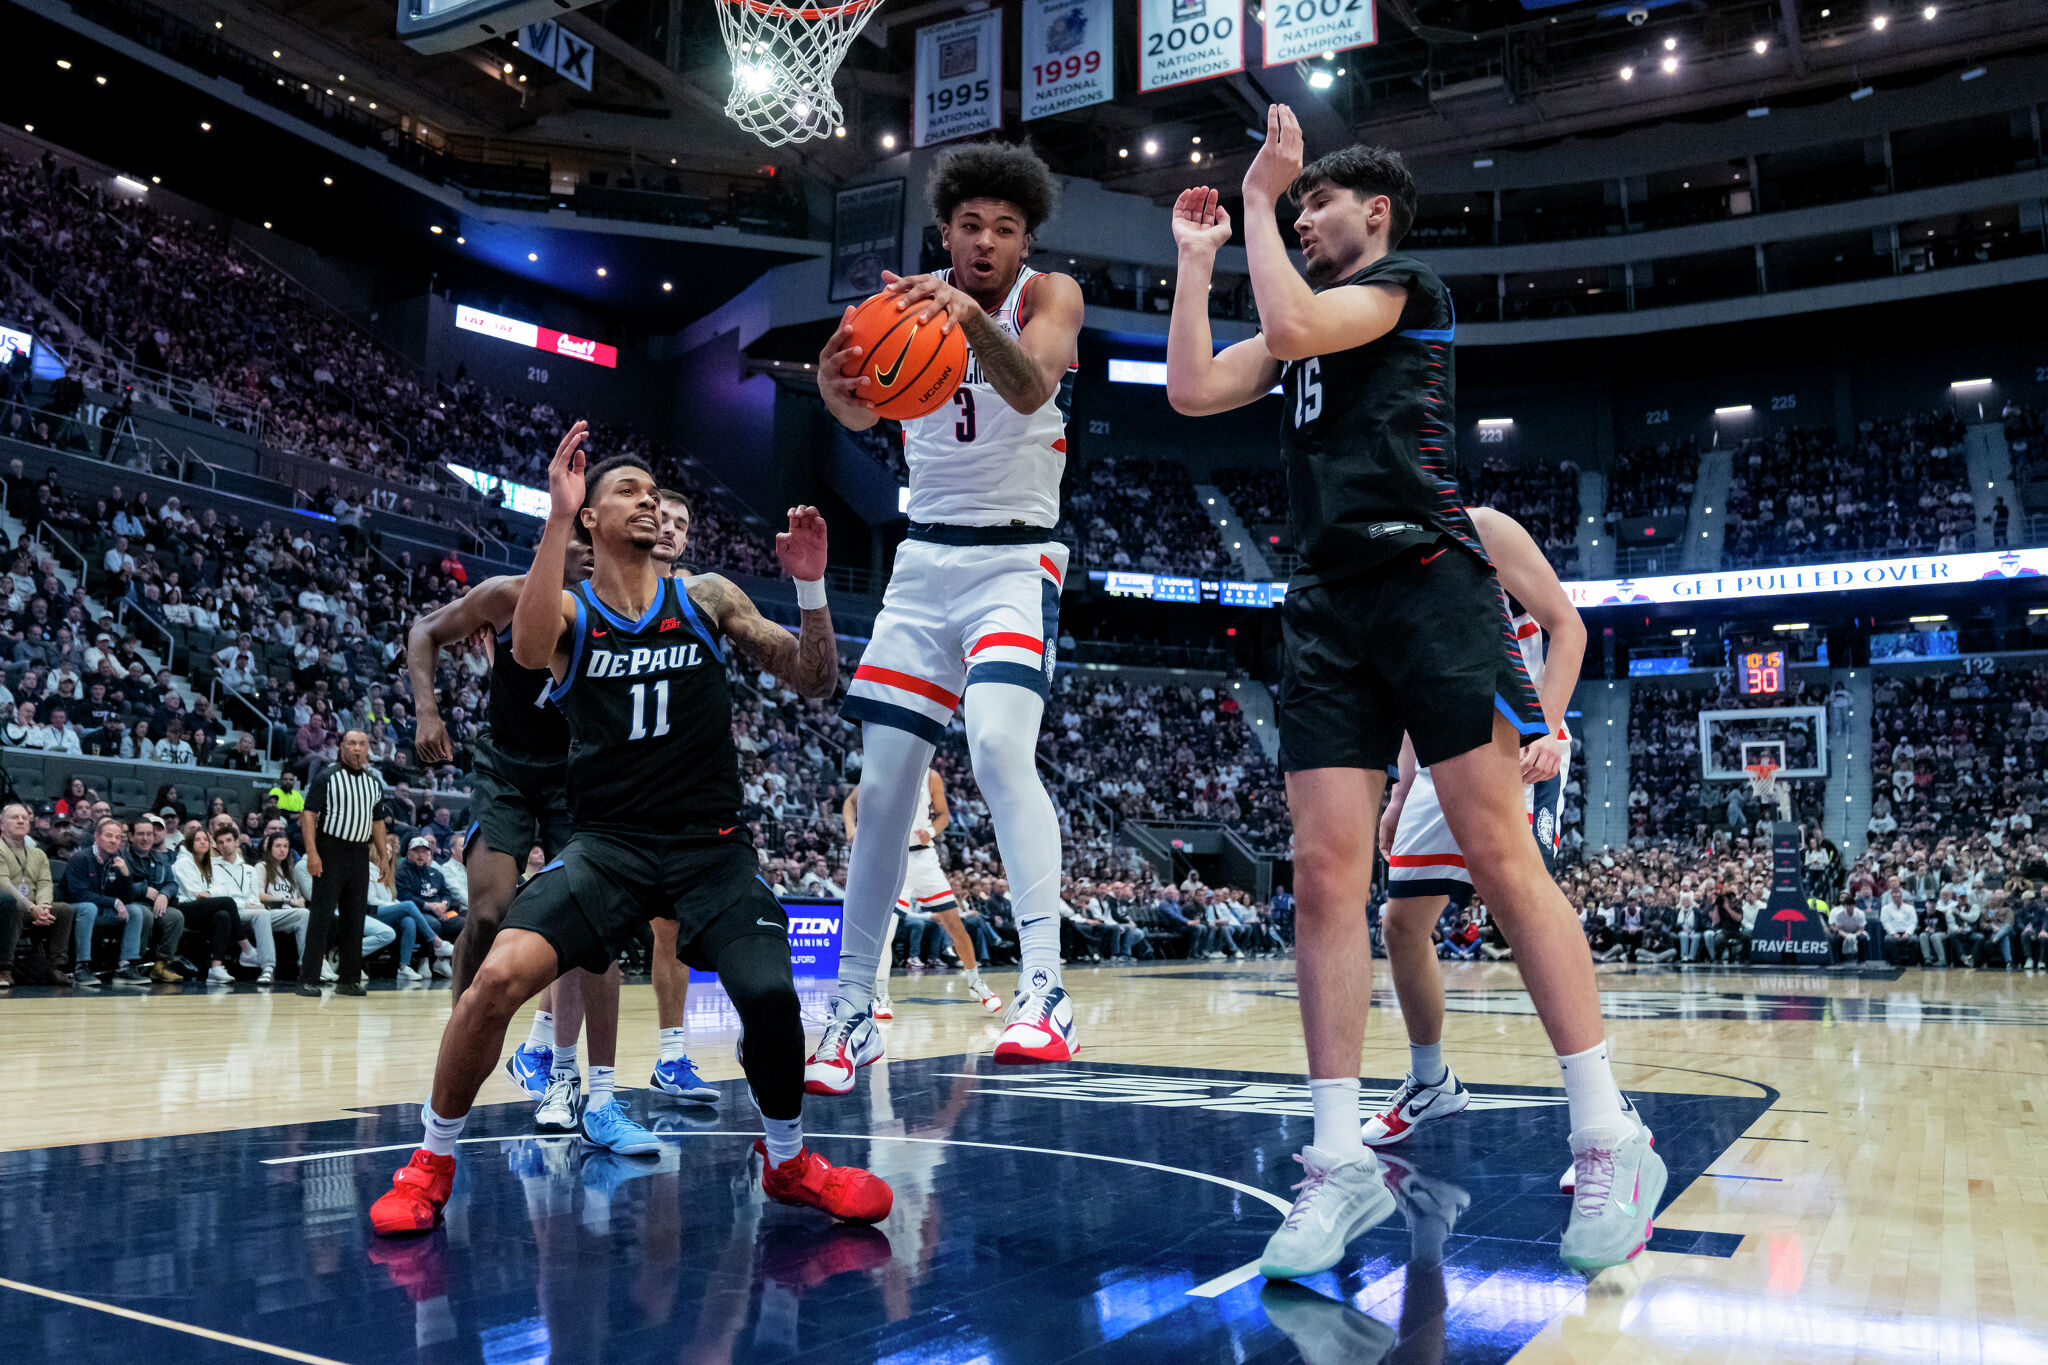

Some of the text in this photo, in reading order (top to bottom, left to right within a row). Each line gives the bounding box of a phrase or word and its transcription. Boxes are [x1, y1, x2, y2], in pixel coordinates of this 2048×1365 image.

[1147, 17, 1233, 57] 2000
[1283, 18, 1355, 42] NATIONAL
[1277, 31, 1362, 59] CHAMPIONS
[1032, 50, 1101, 86] 1999
[1156, 47, 1224, 70] NATIONAL
[1151, 59, 1230, 86] CHAMPIONS
[926, 80, 990, 115] 1995
[1035, 79, 1098, 101] NATIONAL
[1030, 90, 1104, 117] CHAMPIONS
[929, 107, 987, 129] NATIONAL
[924, 119, 992, 143] CHAMPIONS
[527, 366, 549, 384] 219
[918, 366, 952, 404] UCONN
[1294, 356, 1323, 430] 15
[1771, 395, 1796, 411] 225
[952, 387, 976, 443] 3
[1089, 419, 1110, 435] 221
[1646, 410, 1669, 425] 224
[1479, 429, 1503, 443] 223
[371, 487, 398, 510] 117
[1672, 562, 1949, 596] GET PULLED OVER
[1746, 652, 1781, 668] 10:15
[1747, 667, 1779, 694] 30
[628, 680, 671, 740] 11
[1751, 939, 1829, 954] TRAVELERS
